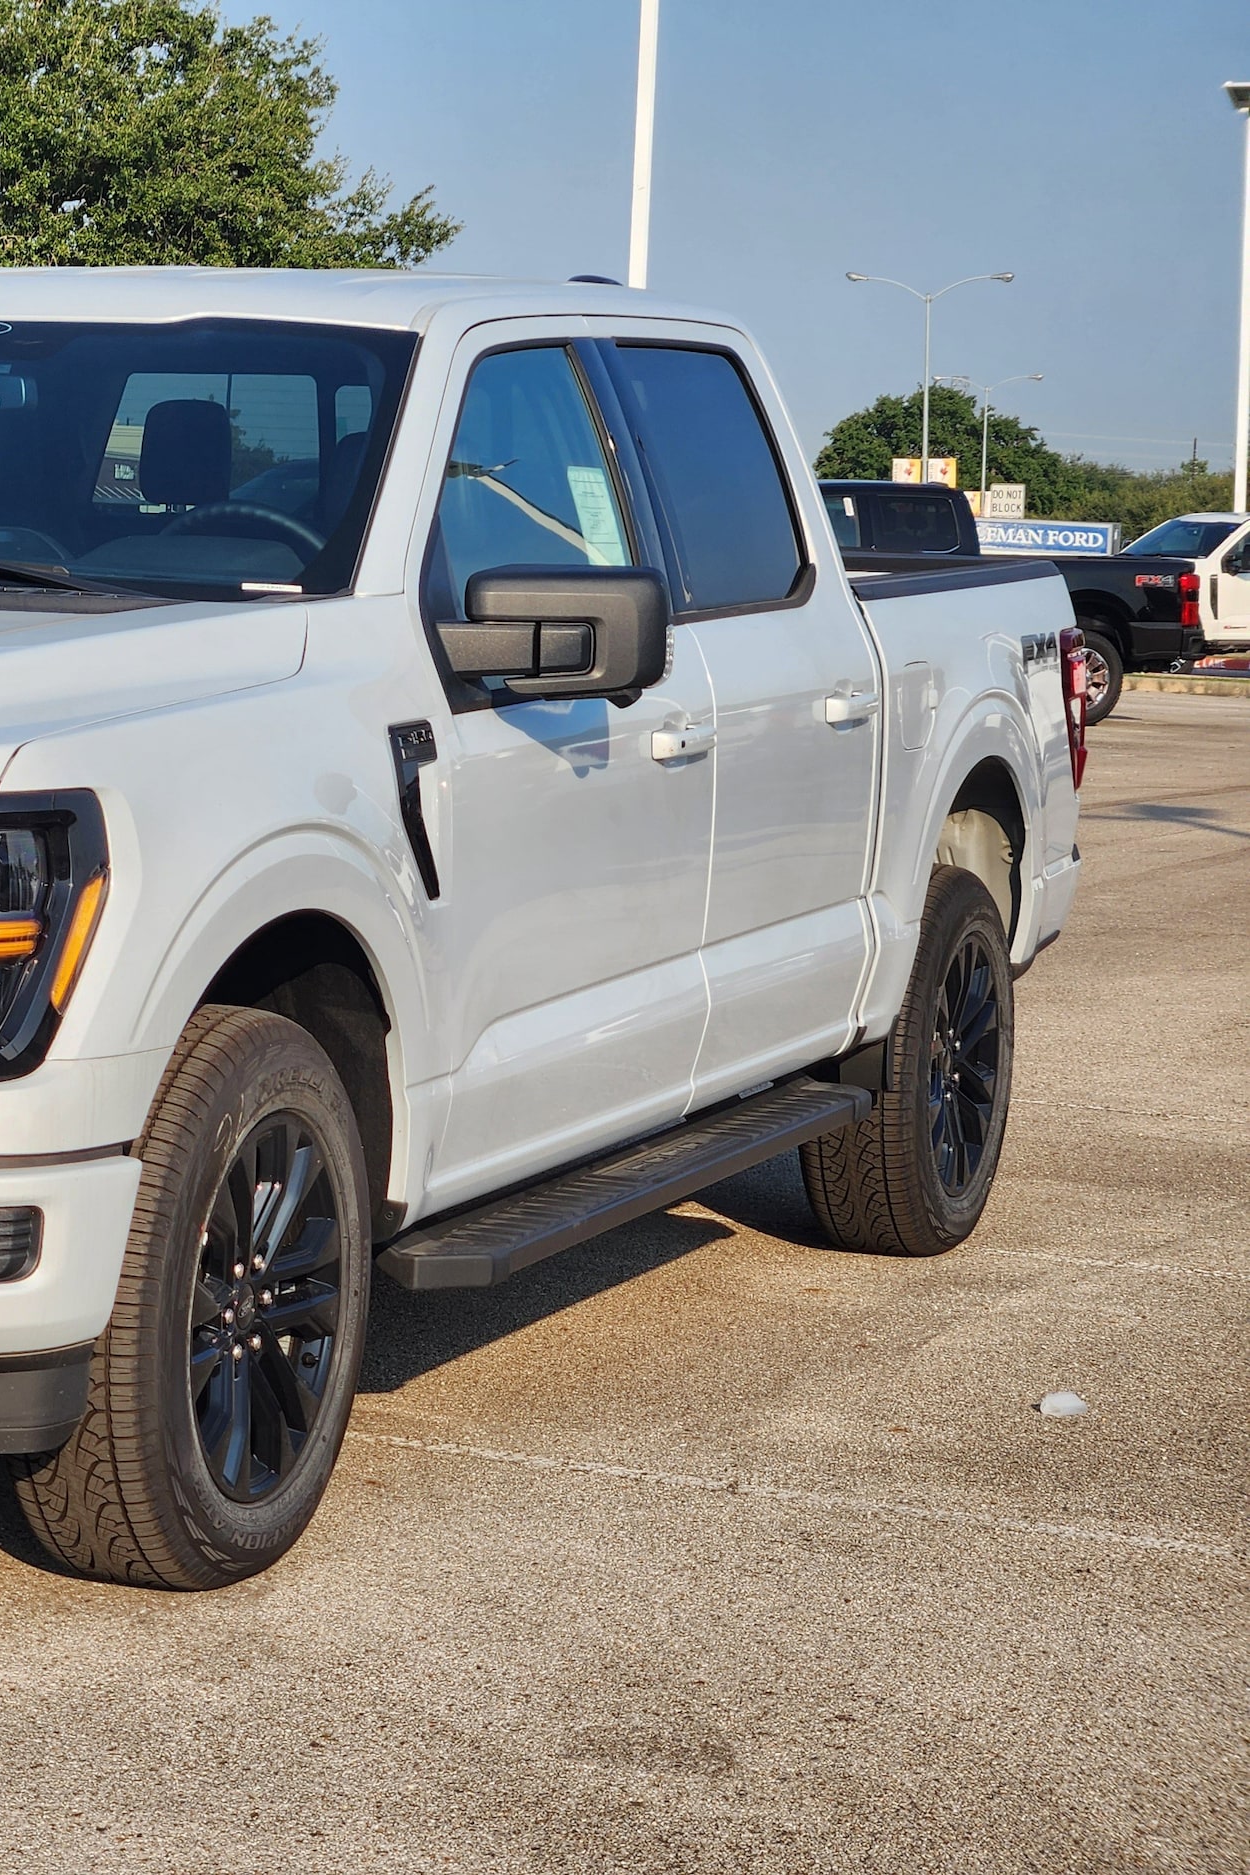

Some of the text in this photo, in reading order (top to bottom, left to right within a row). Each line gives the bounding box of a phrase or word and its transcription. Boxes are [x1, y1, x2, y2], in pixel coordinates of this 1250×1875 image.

[992, 489, 1022, 500] DO NOT
[992, 503, 1022, 512] BLOCK
[1047, 529, 1104, 548] FORD
[1135, 574, 1174, 587] FX4
